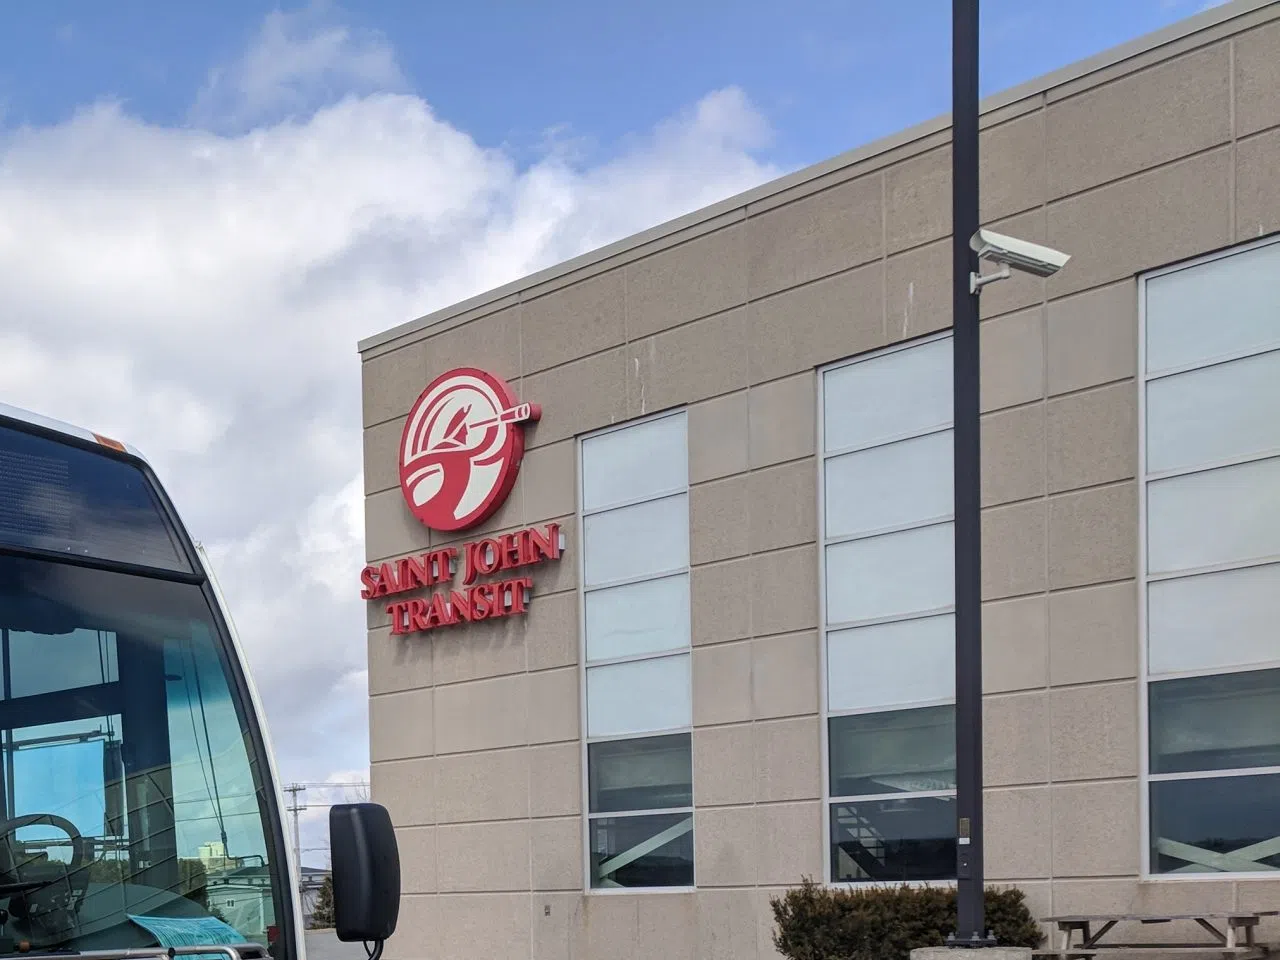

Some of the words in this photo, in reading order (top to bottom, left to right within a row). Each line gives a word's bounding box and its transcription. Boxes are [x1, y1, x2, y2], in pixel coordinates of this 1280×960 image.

[361, 548, 457, 599] SAINT
[463, 523, 560, 585] JOHN
[385, 576, 533, 636] TRANSIT
